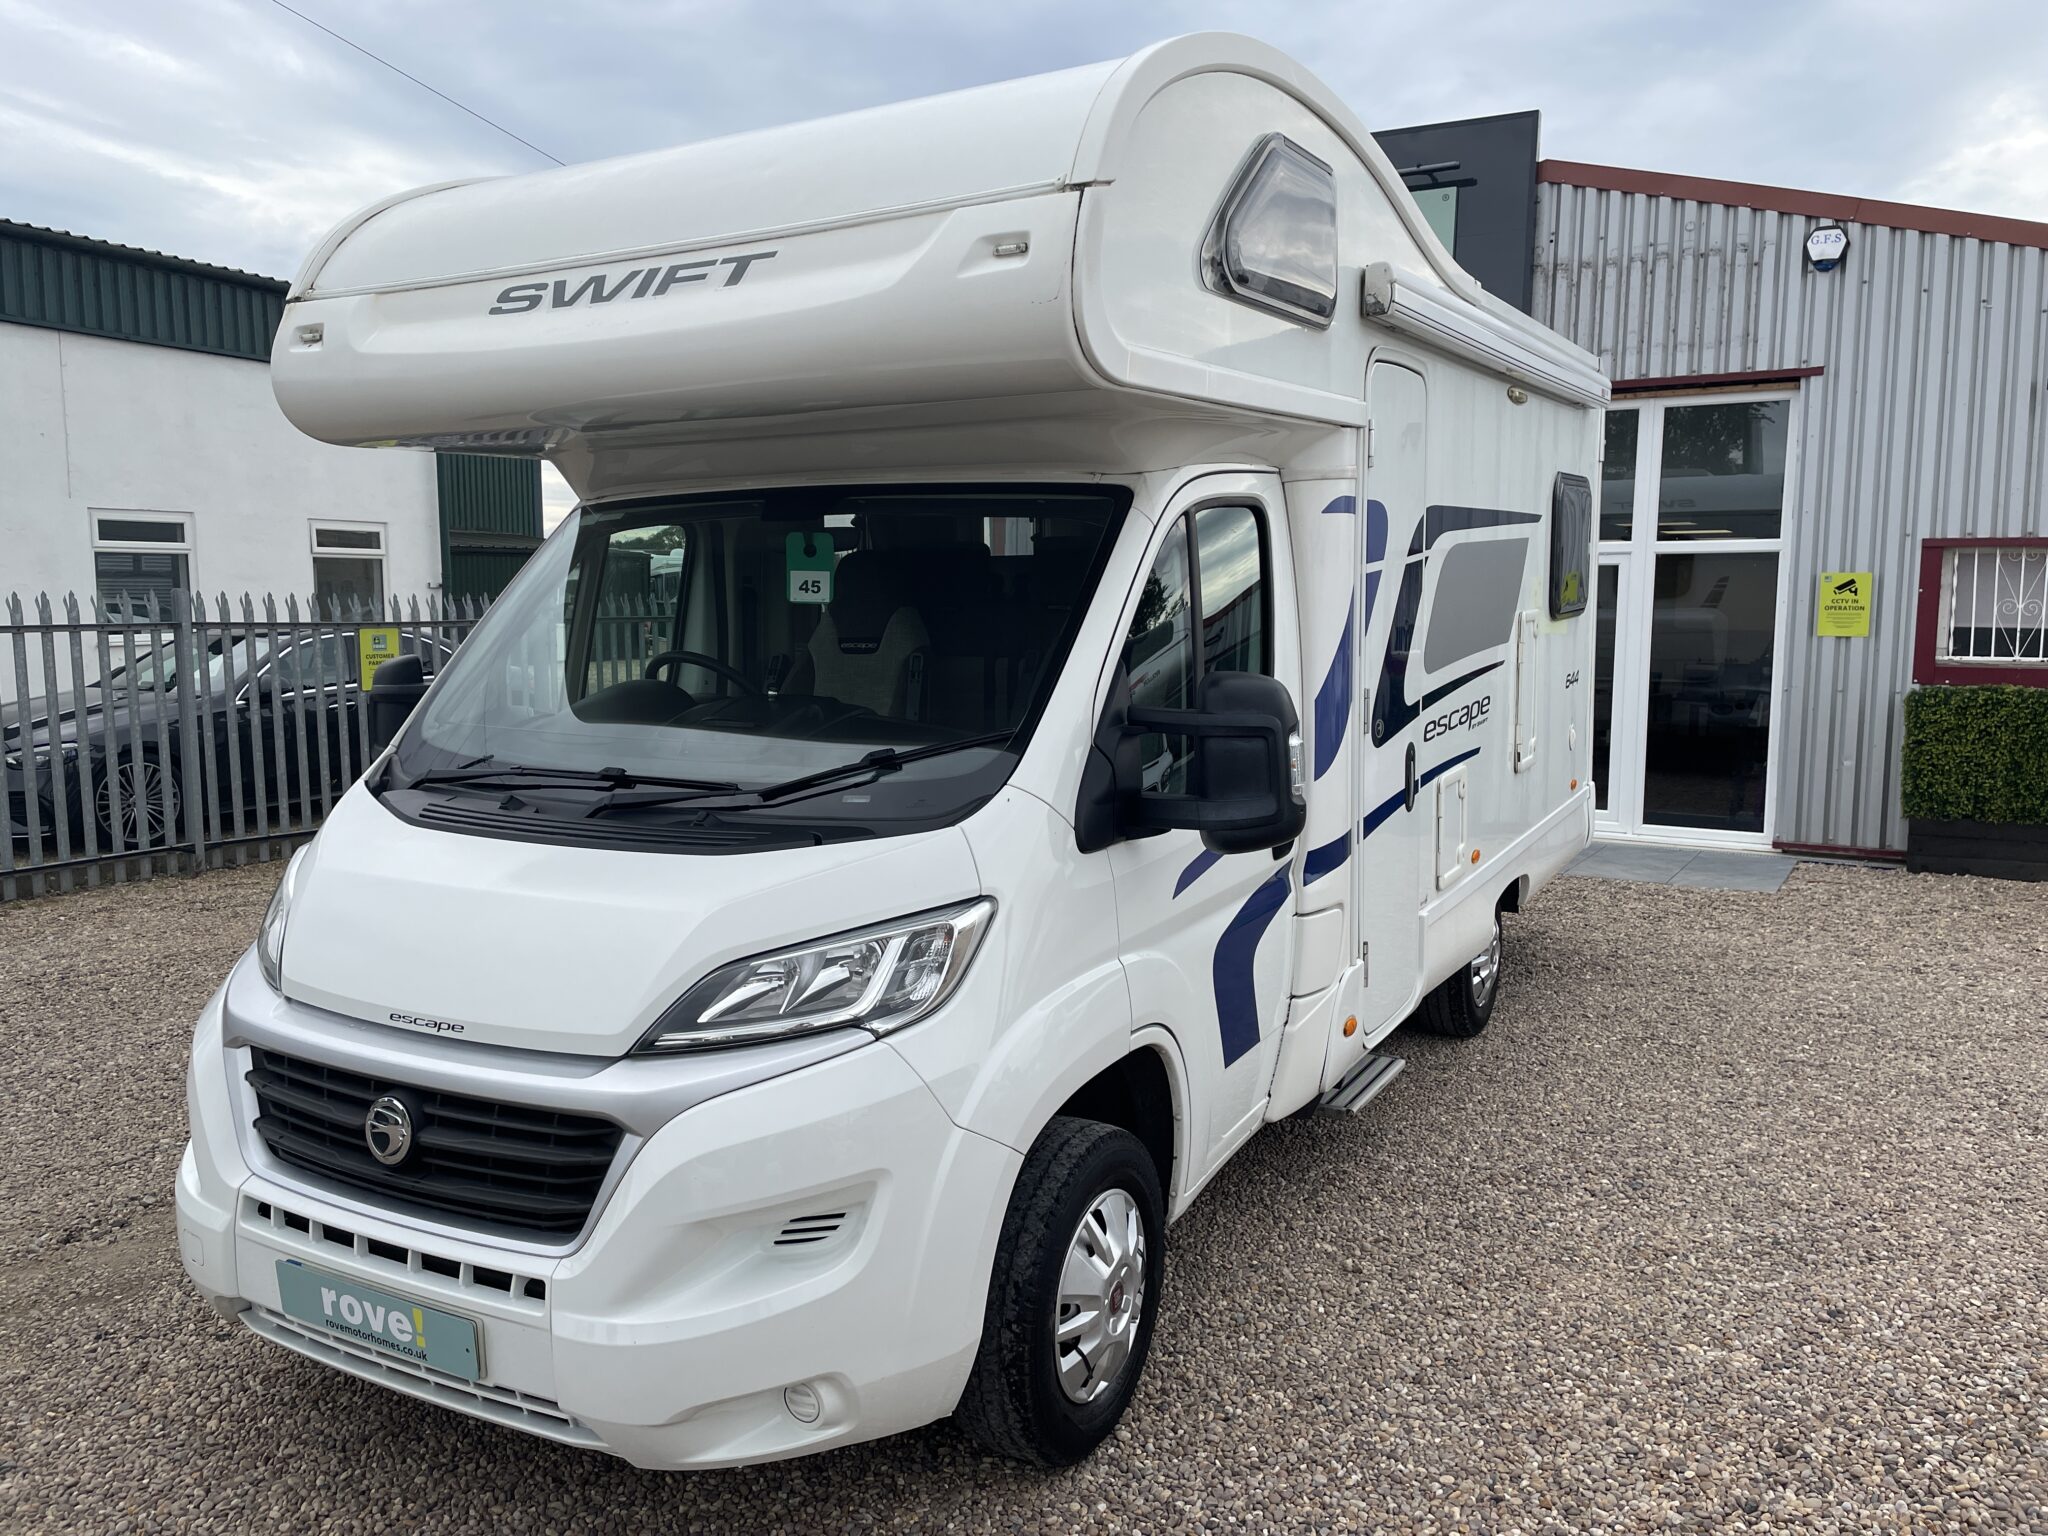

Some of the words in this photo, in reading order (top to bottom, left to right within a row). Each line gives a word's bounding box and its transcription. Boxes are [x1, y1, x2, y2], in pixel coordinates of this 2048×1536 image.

[1811, 233, 1842, 245] G.F.S
[488, 250, 778, 315] SWIFT
[798, 579, 822, 594] 45
[1423, 695, 1491, 742] escape
[389, 1013, 465, 1033] escape
[320, 1286, 427, 1348] rove!
[325, 1318, 428, 1362] rovemotorhomes.co.uk
